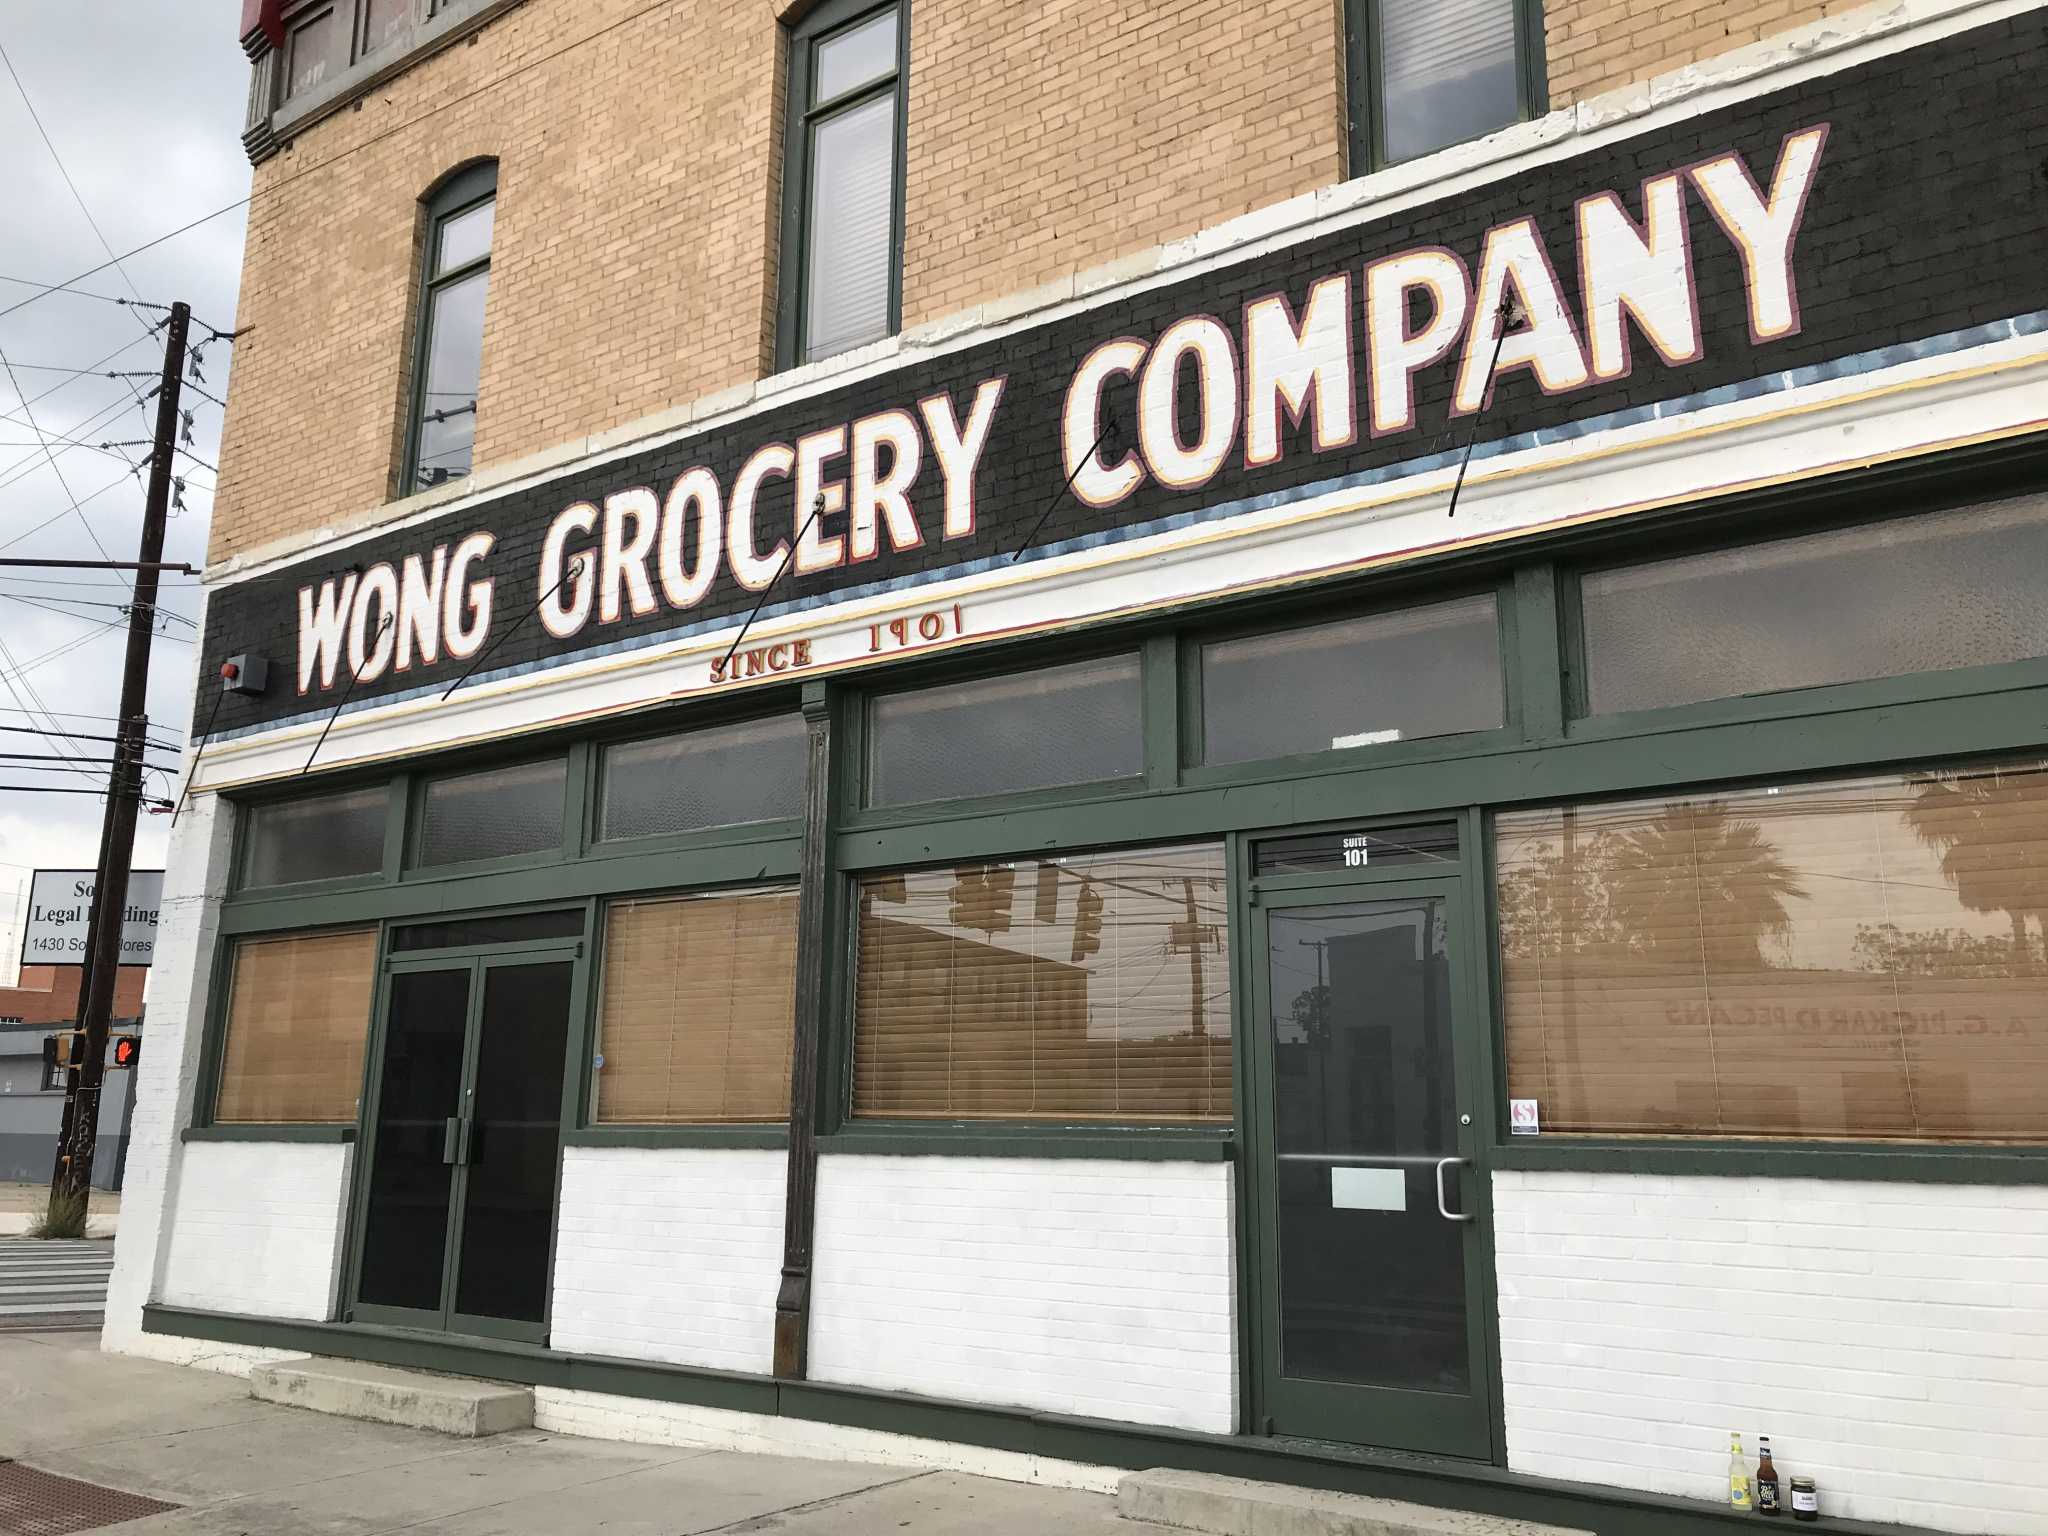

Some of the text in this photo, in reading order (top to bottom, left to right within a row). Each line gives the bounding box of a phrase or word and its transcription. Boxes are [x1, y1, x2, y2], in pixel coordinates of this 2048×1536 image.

[297, 122, 1831, 696] WONG GROCERY COMPANY
[709, 601, 963, 683] SINCE 1901
[1343, 837, 1368, 848] SUITE
[1343, 849, 1368, 867] 101
[34, 905, 81, 926] Legal
[33, 938, 65, 951] 1430
[119, 938, 153, 951] lores
